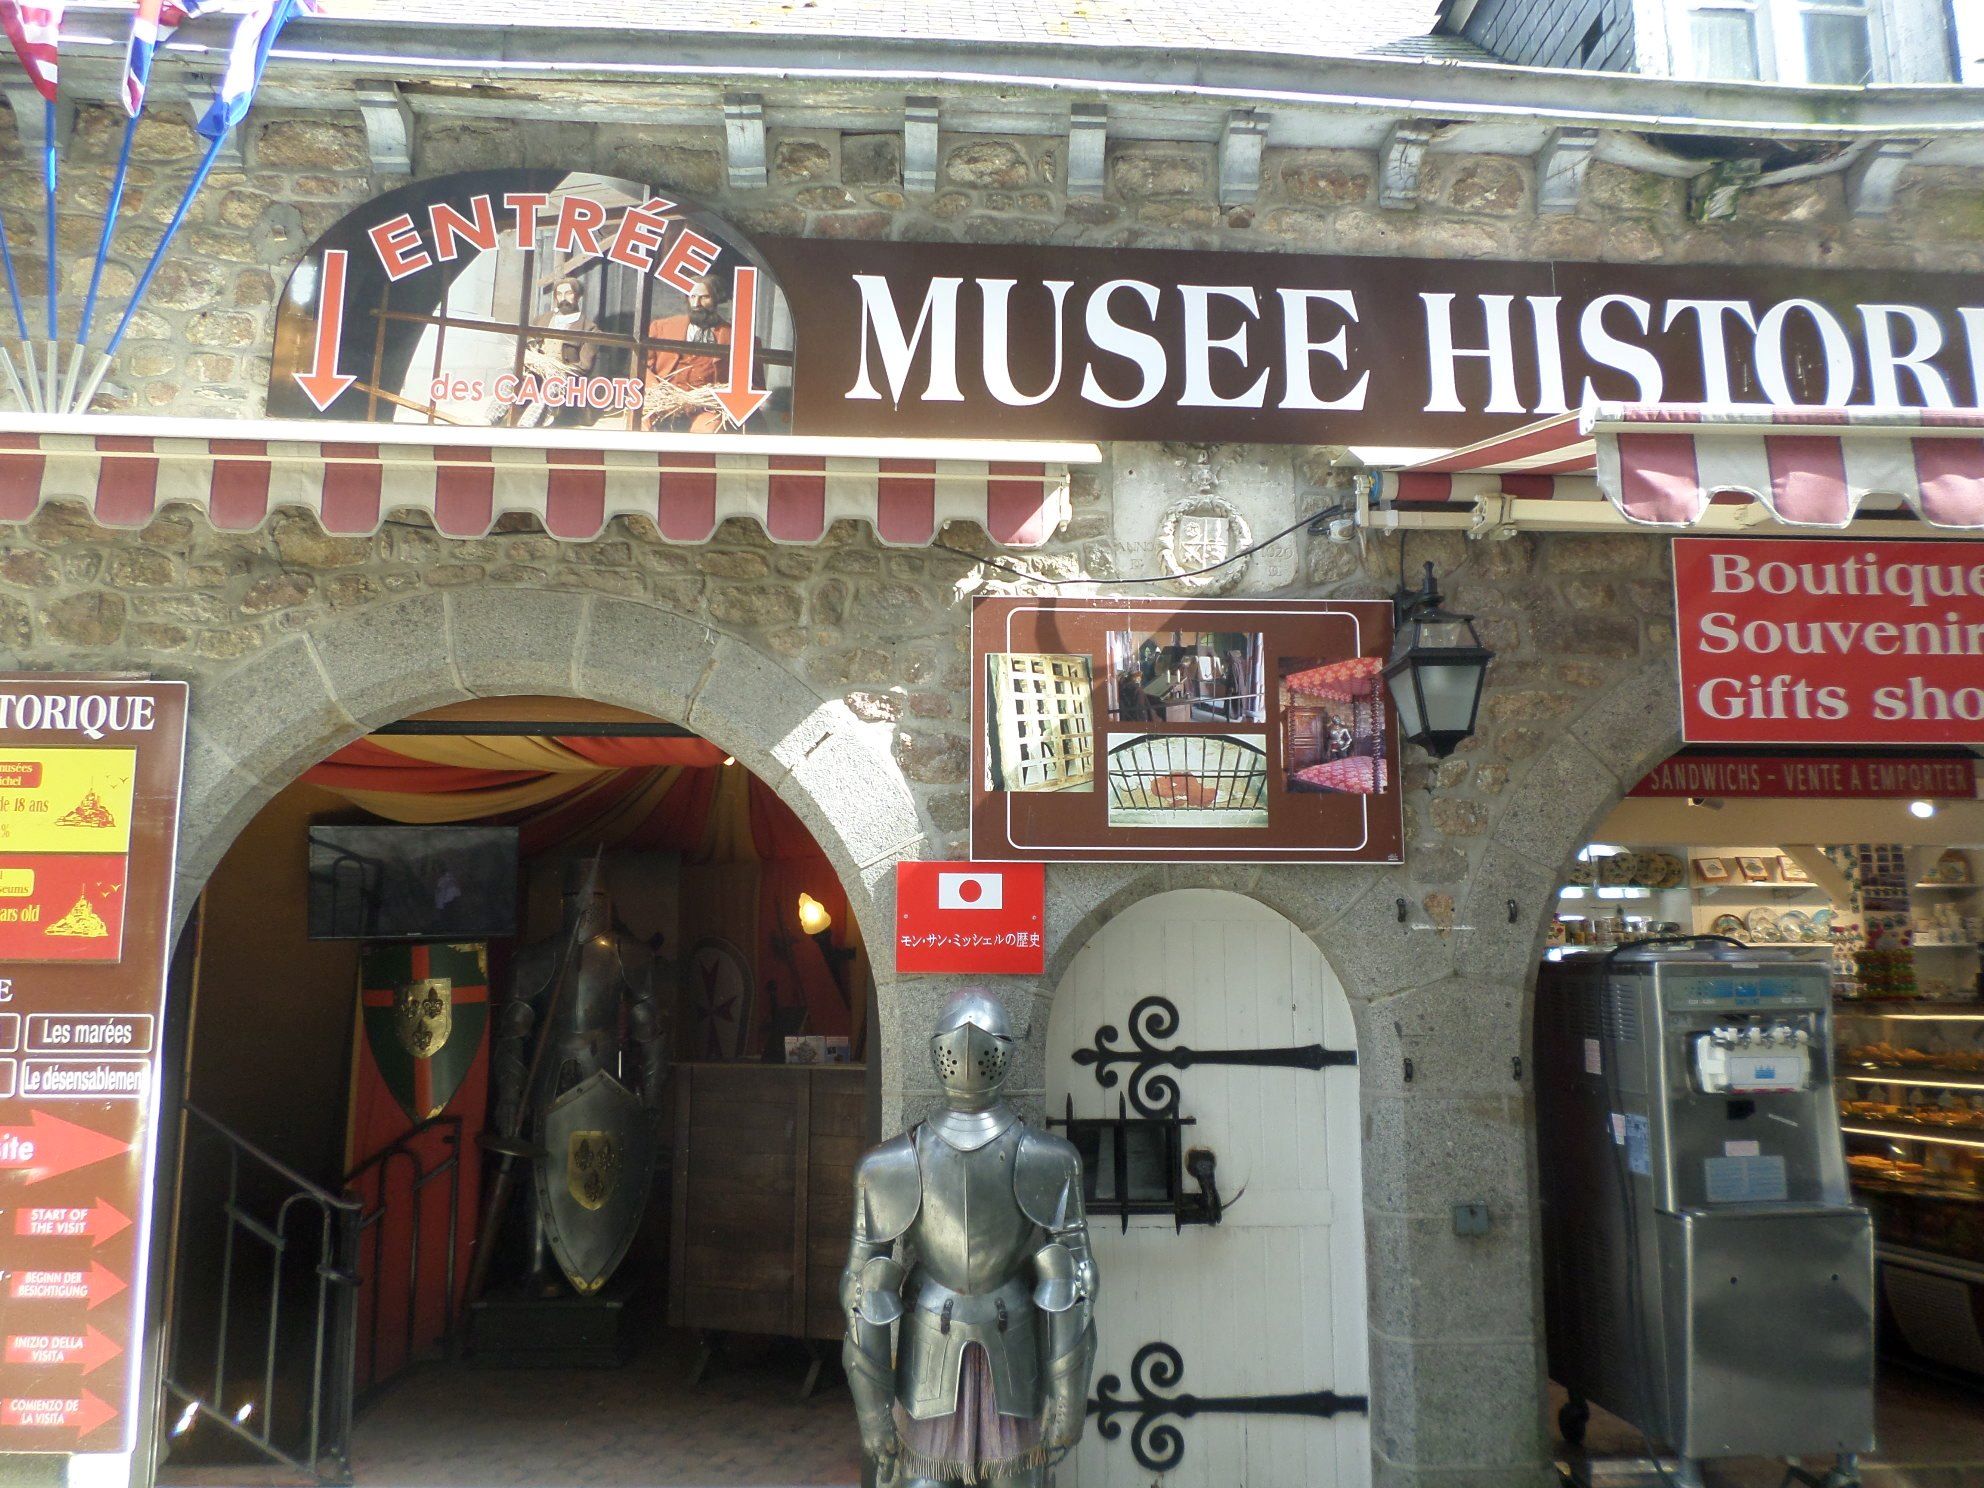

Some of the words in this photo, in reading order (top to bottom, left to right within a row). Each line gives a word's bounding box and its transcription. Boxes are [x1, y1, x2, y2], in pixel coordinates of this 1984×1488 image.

[367, 193, 722, 298] ENTRÉE
[844, 274, 1370, 411] MUSEE
[430, 372, 484, 402] des
[493, 373, 645, 410] CACHOTS
[1699, 675, 1849, 720] Gifts
[1650, 763, 1760, 791] SANDWICHS
[1783, 763, 1843, 791] VENTE
[1850, 763, 1861, 791] A
[1868, 764, 1967, 792] EMPORTER
[14, 797, 26, 812] 18
[29, 799, 49, 813] ans
[21, 904, 40, 922] old
[42, 1018, 71, 1044] Les
[74, 1018, 132, 1044] marées
[24, 1065, 41, 1091] Le
[31, 1208, 66, 1220] START
[69, 1208, 88, 1220] OF
[31, 1221, 53, 1233] THE
[56, 1221, 86, 1234] VISIT
[25, 1271, 61, 1284] BEGINN
[18, 1284, 88, 1297] BESICHTIGUNG
[14, 1336, 49, 1349] INIZIO
[51, 1337, 83, 1349] DELLA
[31, 1350, 65, 1362] VISITA
[10, 1398, 63, 1411] COMIENZO
[65, 1399, 80, 1411] DE
[20, 1412, 33, 1424] LA
[36, 1412, 65, 1425] VISITA
